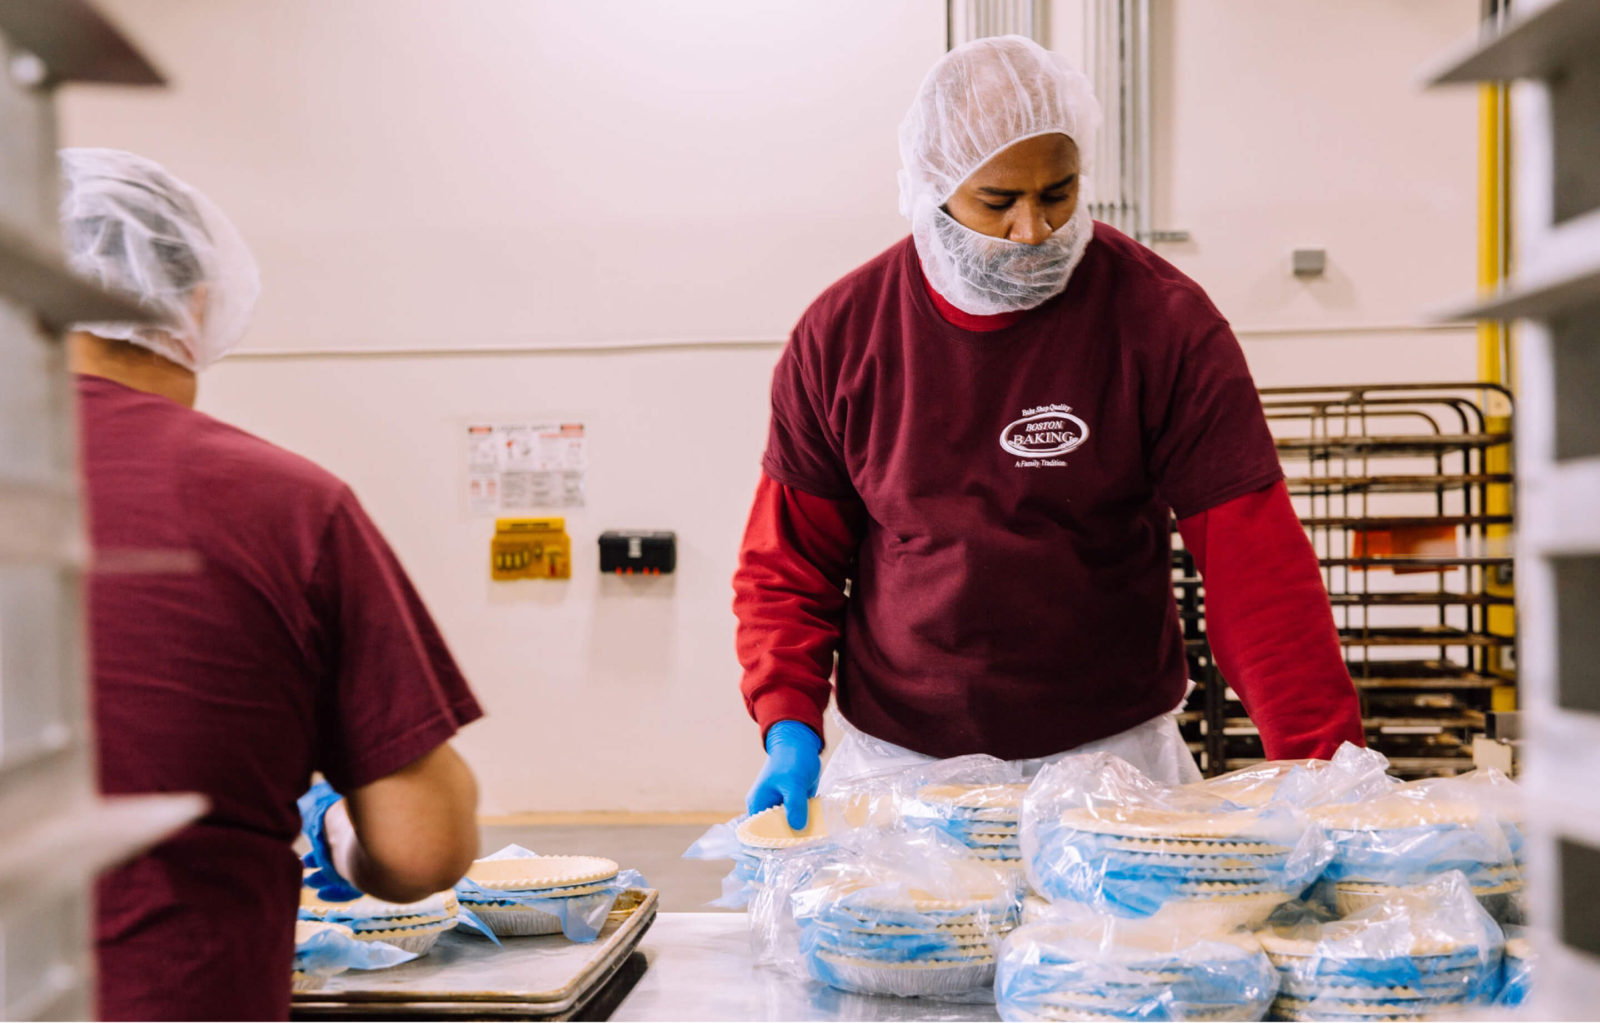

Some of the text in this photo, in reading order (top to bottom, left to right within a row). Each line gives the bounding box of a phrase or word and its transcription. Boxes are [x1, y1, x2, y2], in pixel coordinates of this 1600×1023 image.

[1036, 405, 1050, 413] Shop
[1050, 403, 1072, 412] Quality
[1025, 421, 1065, 432] BOSTON
[1013, 431, 1076, 445] BAKING
[1021, 460, 1041, 469] Family
[1041, 459, 1068, 467] Tradition
